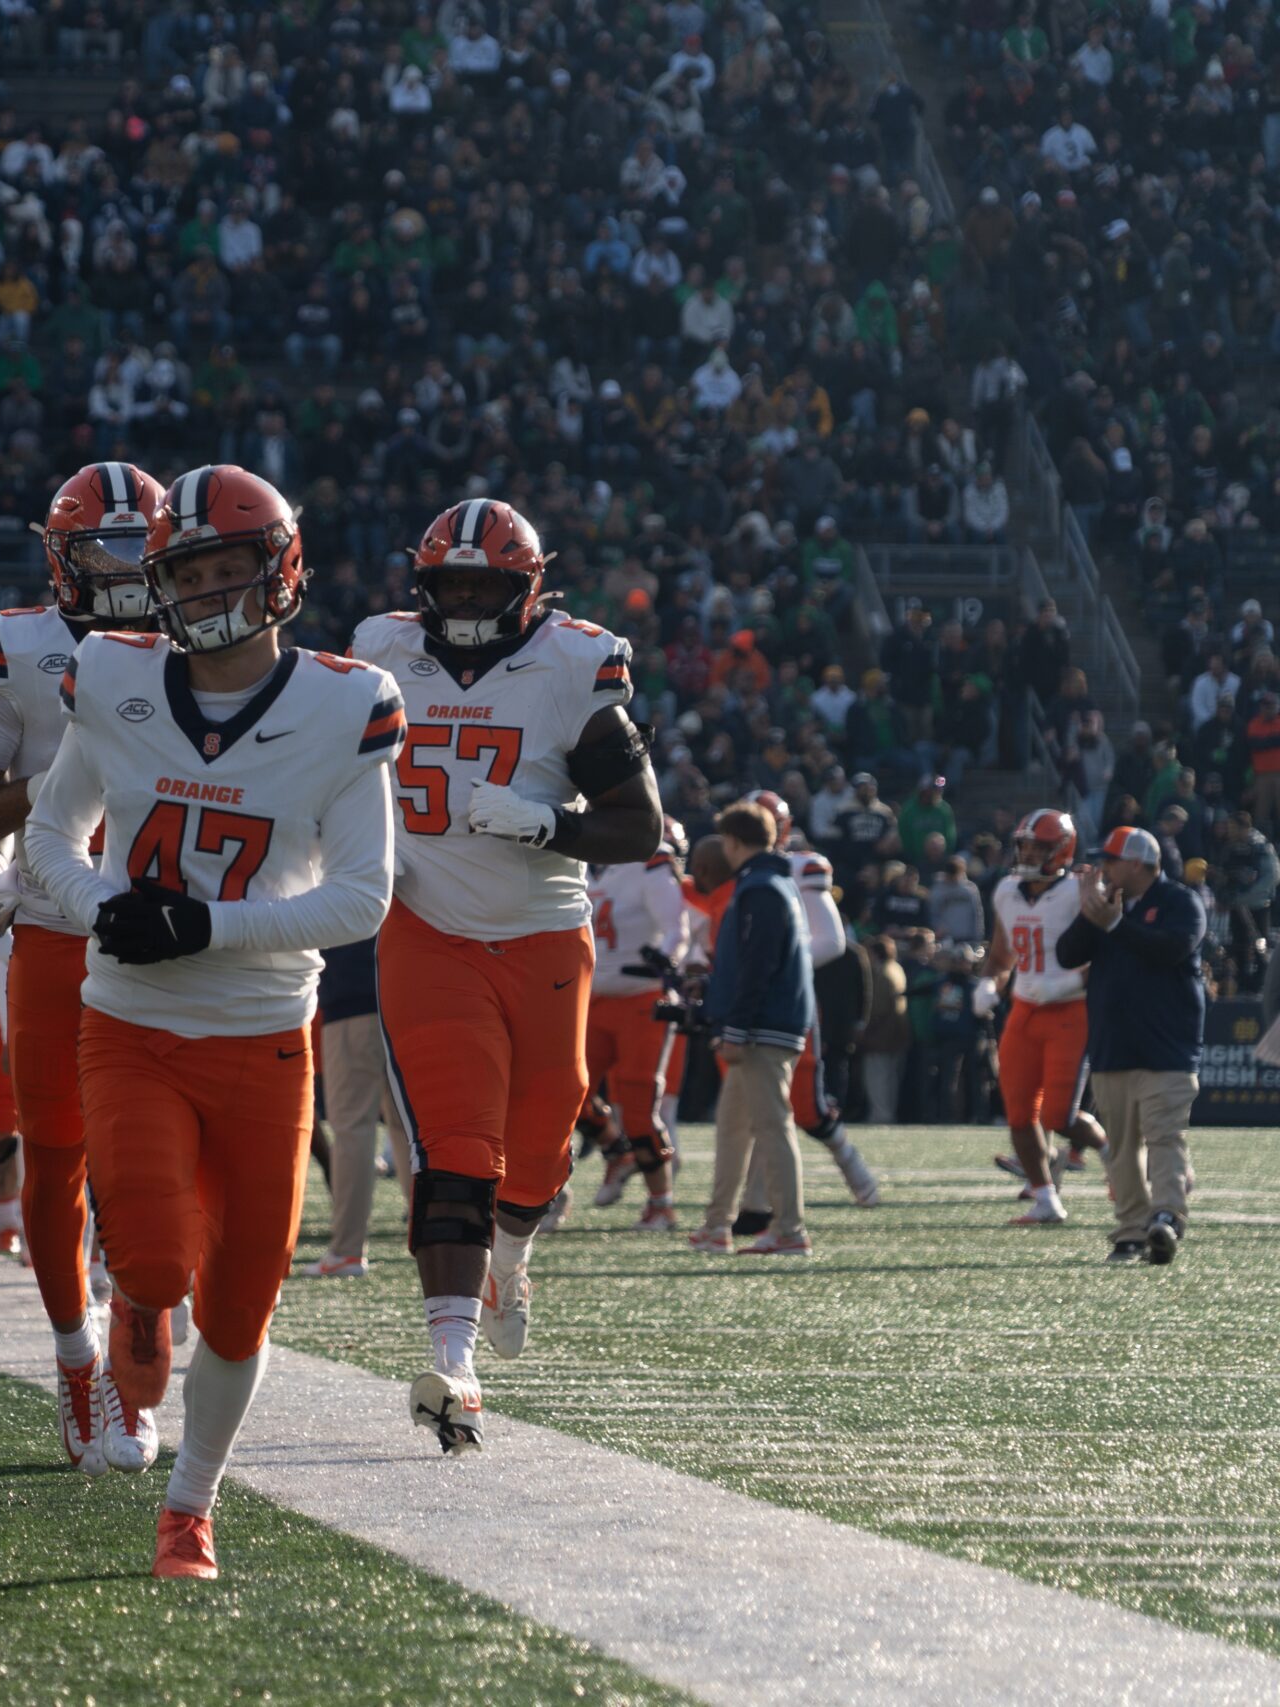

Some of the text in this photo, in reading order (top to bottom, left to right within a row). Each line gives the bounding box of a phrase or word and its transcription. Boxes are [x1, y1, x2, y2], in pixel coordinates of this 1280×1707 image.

[427, 703, 495, 720] ORANGE
[203, 732, 220, 755] S
[155, 776, 245, 805] ORANGE
[396, 724, 524, 836] 57
[126, 799, 276, 902] 47
[596, 898, 618, 951] 4
[1013, 926, 1045, 974] 91
